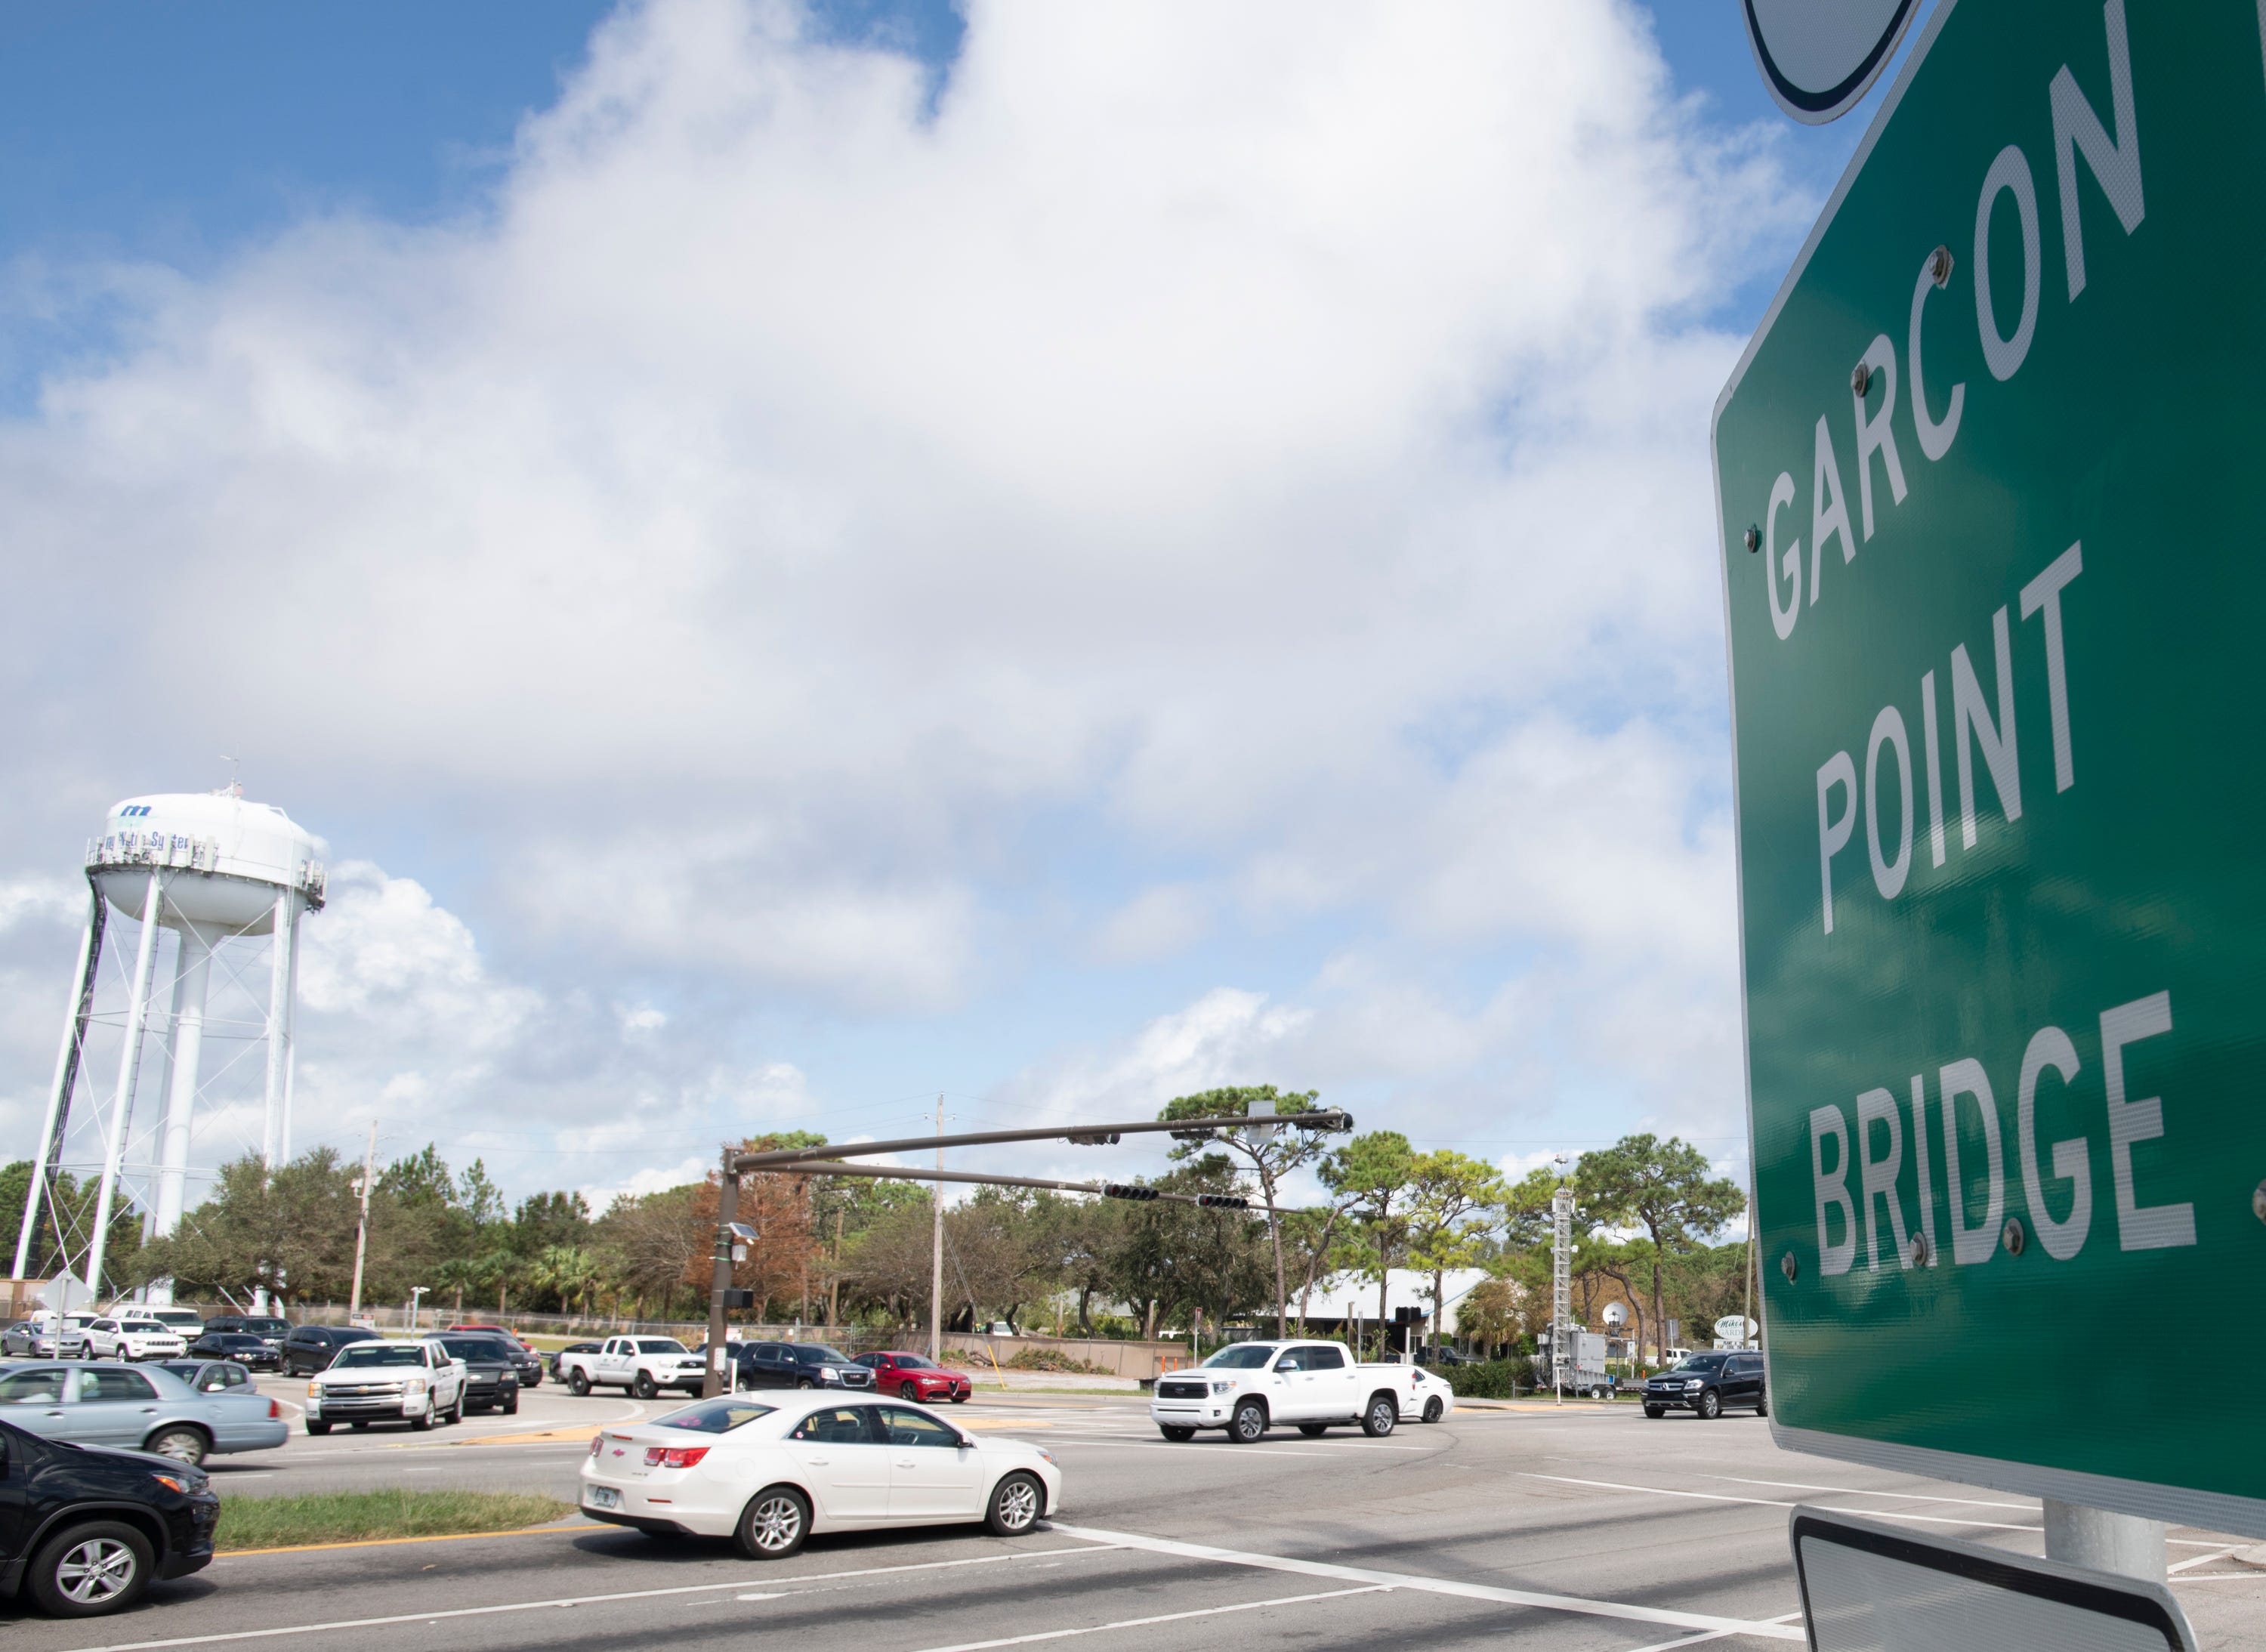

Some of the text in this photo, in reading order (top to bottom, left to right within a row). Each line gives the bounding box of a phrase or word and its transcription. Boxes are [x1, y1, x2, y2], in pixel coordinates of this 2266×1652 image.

[1765, 0, 2146, 641] GARCON
[1816, 539, 2083, 937] POINT
[1808, 989, 2197, 1277] BRIDGE
[1717, 1319, 1743, 1329] Mike's
